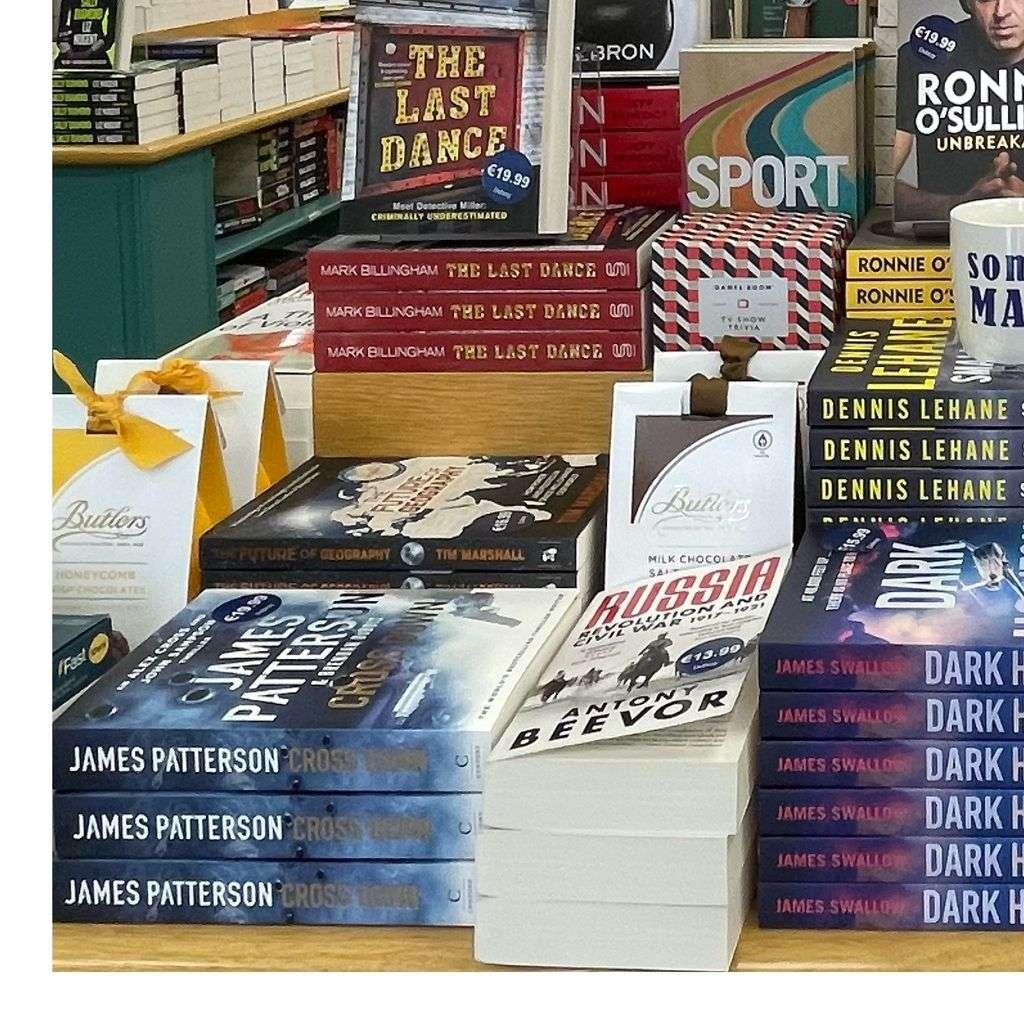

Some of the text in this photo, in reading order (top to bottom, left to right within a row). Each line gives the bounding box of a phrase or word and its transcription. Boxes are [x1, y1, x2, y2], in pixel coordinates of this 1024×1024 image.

[913, 24, 958, 54] €19.99
[408, 44, 486, 79] THE
[395, 84, 497, 125] LAST
[380, 126, 508, 173] DANCE
[487, 163, 530, 189] €19.99
[686, 154, 850, 209] SPORT
[393, 202, 415, 211] Meet
[416, 201, 458, 211] Detective
[320, 262, 597, 278] MARK BILLINGHAM THE LAST DANCE
[857, 255, 926, 274] RONNIE
[821, 397, 910, 421] DENNIS
[919, 397, 1009, 420] LEHANE
[52, 499, 151, 538] Butlers
[239, 547, 299, 562] FUTURE
[460, 547, 526, 562] MARSHALL
[648, 555, 675, 564] MILK
[584, 556, 782, 630] RUSSIA
[874, 540, 968, 611] DARK
[572, 617, 684, 648] CIVIL WAR
[578, 592, 768, 640] REVOLUTION AND
[188, 614, 307, 692] JAMES
[220, 591, 386, 723] PATTERSON
[680, 643, 742, 664] €13.99
[775, 658, 825, 675] JAMES
[924, 650, 1005, 688] DARK
[561, 685, 700, 720] ANTONY
[509, 690, 729, 751] BEEVOR
[69, 746, 146, 774] JAMES
[151, 746, 280, 774] PATTERSON
